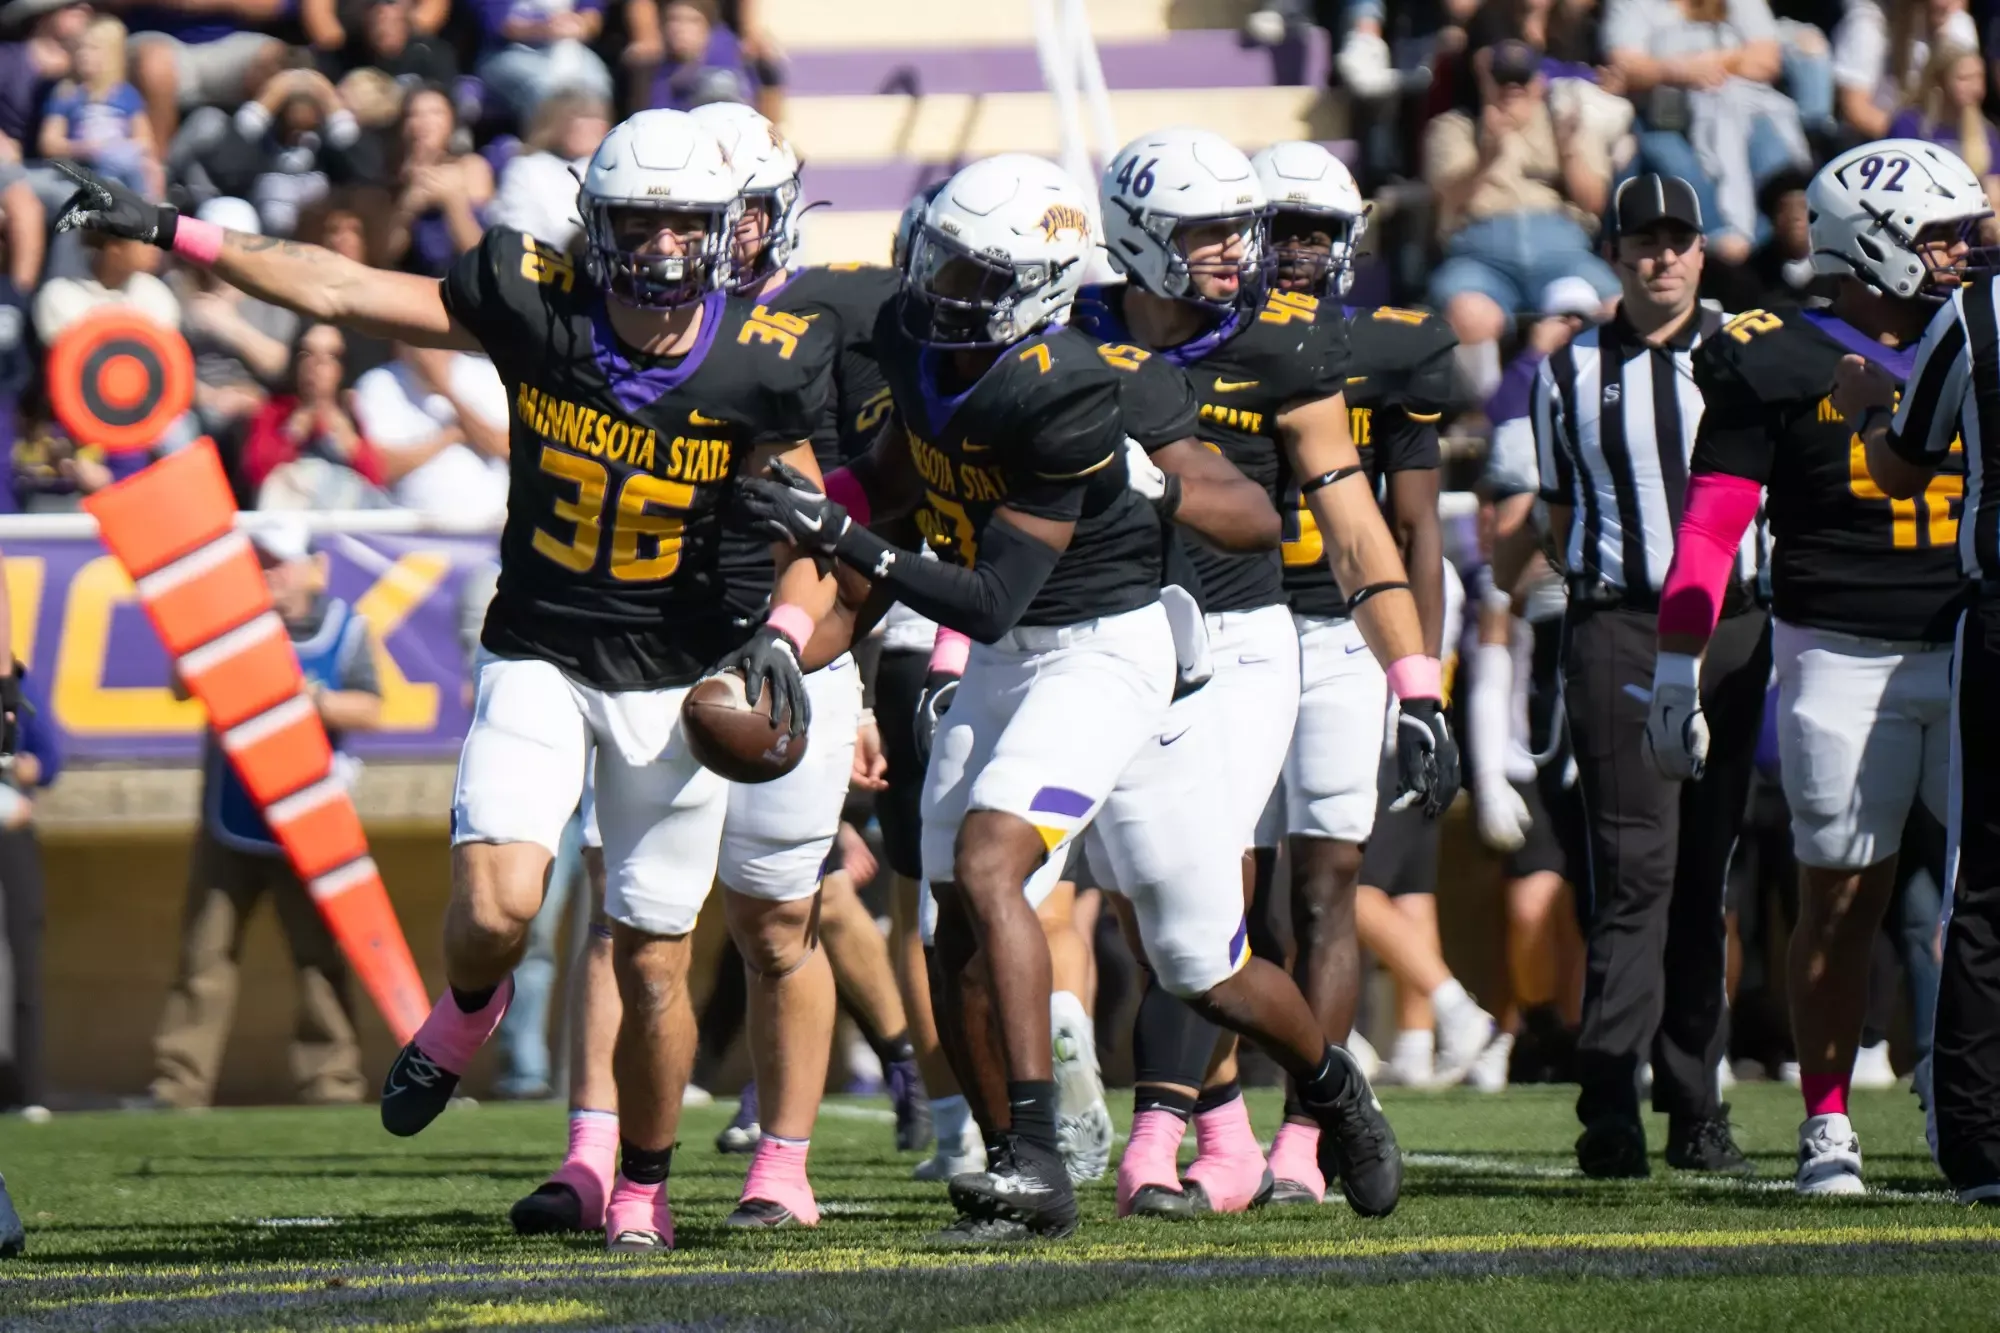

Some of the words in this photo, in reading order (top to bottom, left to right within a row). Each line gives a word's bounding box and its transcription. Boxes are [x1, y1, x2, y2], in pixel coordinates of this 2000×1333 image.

[646, 185, 672, 196] MSU
[1116, 154, 1159, 198] 46
[1858, 155, 1911, 192] 92
[1259, 287, 1320, 326] 46
[737, 304, 810, 360] 36
[1019, 342, 1052, 376] 7
[517, 382, 656, 471] MINNESOTA
[667, 435, 732, 483] STATE
[531, 444, 697, 582] 36
